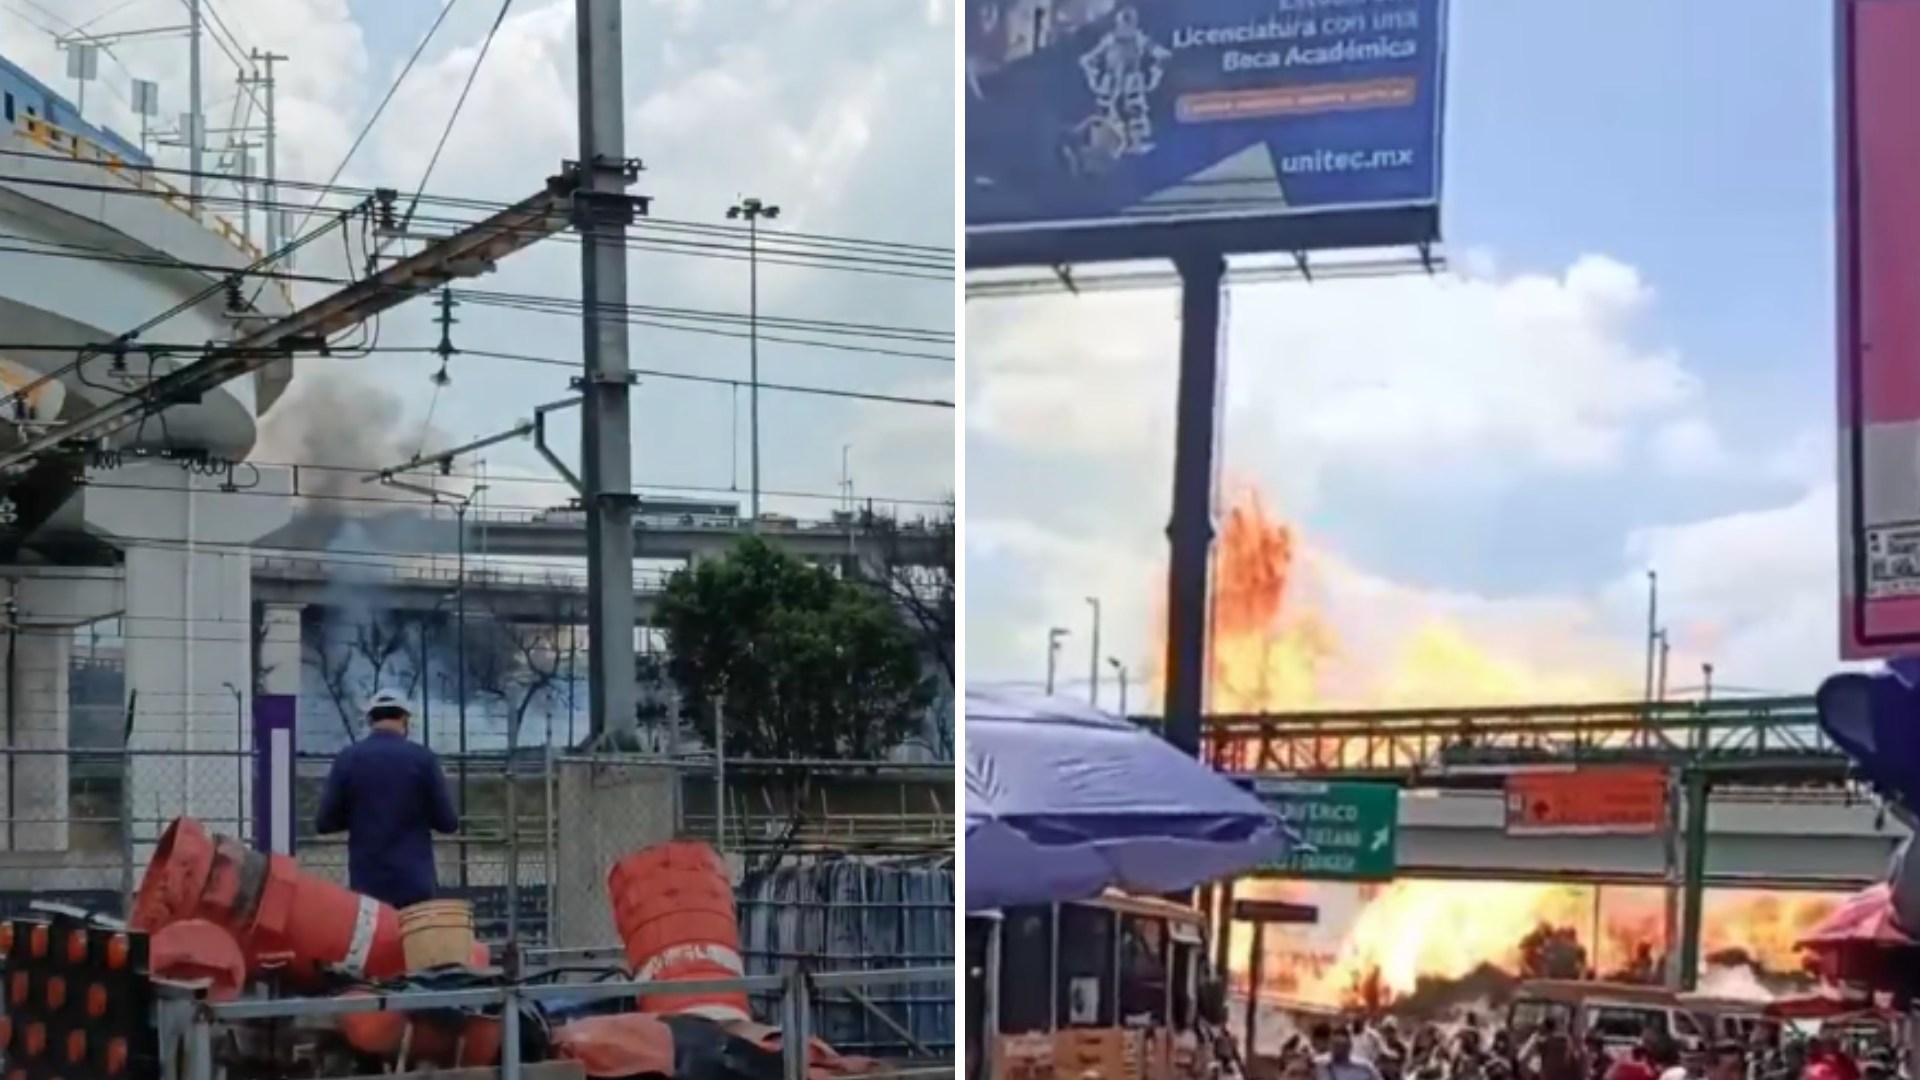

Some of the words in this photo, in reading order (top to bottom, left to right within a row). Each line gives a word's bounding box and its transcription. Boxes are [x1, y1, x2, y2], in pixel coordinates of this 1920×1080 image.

[1173, 19, 1317, 48] Licenciatura
[1322, 16, 1366, 35] con
[1372, 9, 1418, 30] una
[1222, 50, 1280, 71] Beca
[1284, 36, 1417, 66] Académica
[1281, 149, 1414, 173] unitec.mx
